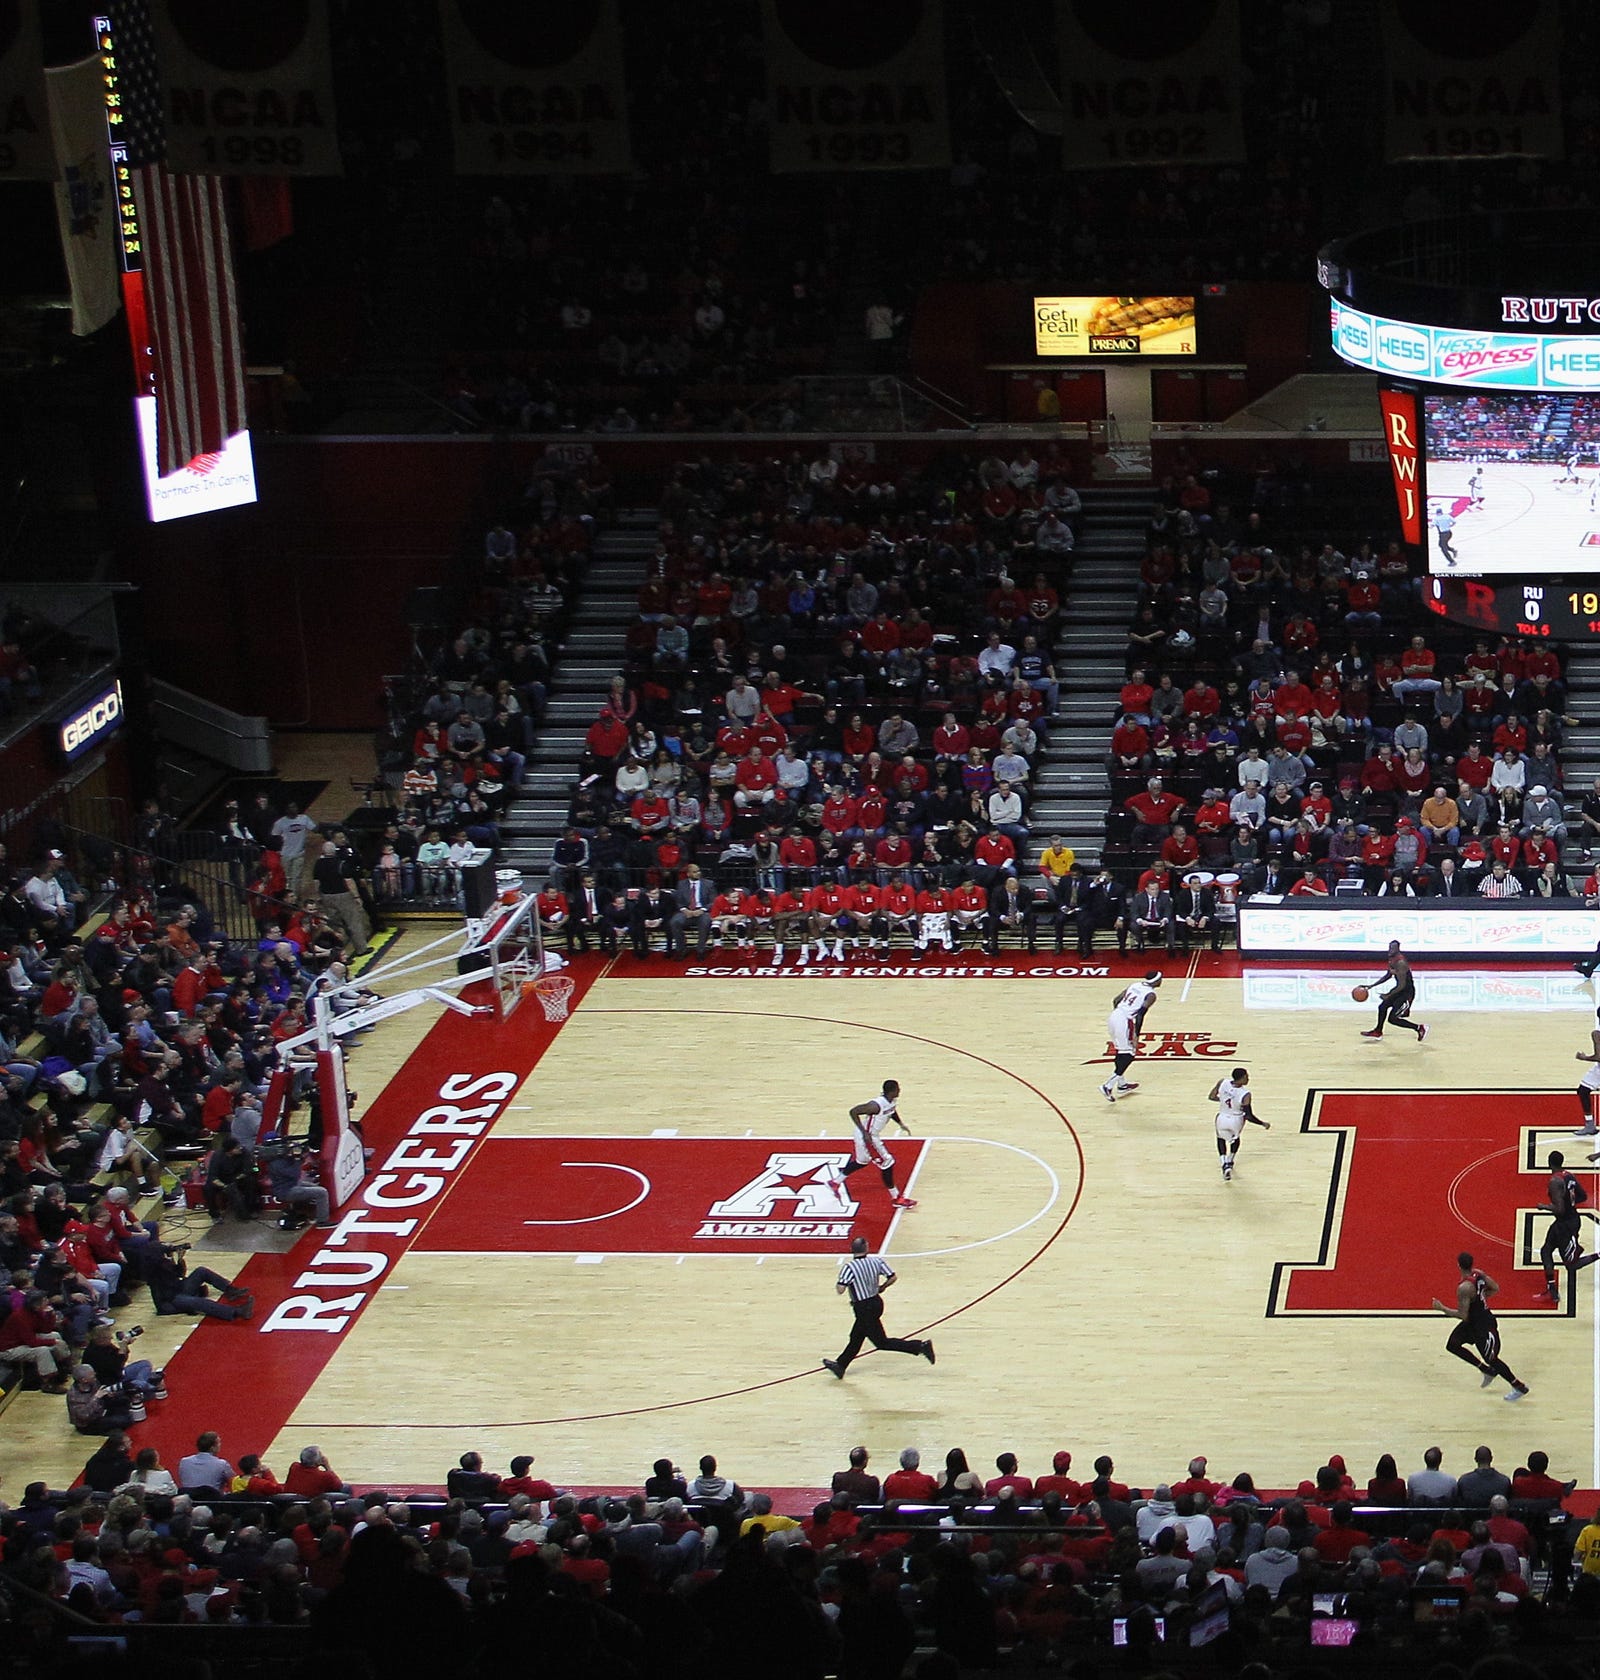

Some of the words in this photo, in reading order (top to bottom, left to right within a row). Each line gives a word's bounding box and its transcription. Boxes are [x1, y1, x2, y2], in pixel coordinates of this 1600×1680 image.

[170, 87, 323, 129] NCAA
[117, 167, 129, 181] 2
[120, 186, 131, 198] 3
[125, 241, 141, 254] 24
[1038, 307, 1068, 322] Get
[1038, 318, 1078, 333] real!
[1092, 338, 1137, 351] PREMIO
[1180, 342, 1192, 352] R
[1378, 336, 1426, 361] HESS
[1437, 336, 1487, 354] HESS
[1388, 413, 1418, 520] RWJ
[1432, 579, 1442, 599] 0
[1523, 586, 1543, 599] RU
[1525, 601, 1540, 621] 0
[1516, 623, 1538, 635] TOL
[63, 692, 119, 752] GEICO
[1251, 923, 1292, 934] HESS
[1373, 924, 1414, 936] HESS
[1427, 924, 1468, 936] HESS
[1551, 924, 1591, 936] HESS
[1225, 1098, 1233, 1109] 4
[260, 1071, 520, 1334] RUTGERS
[694, 1223, 854, 1236] AMERICAN
